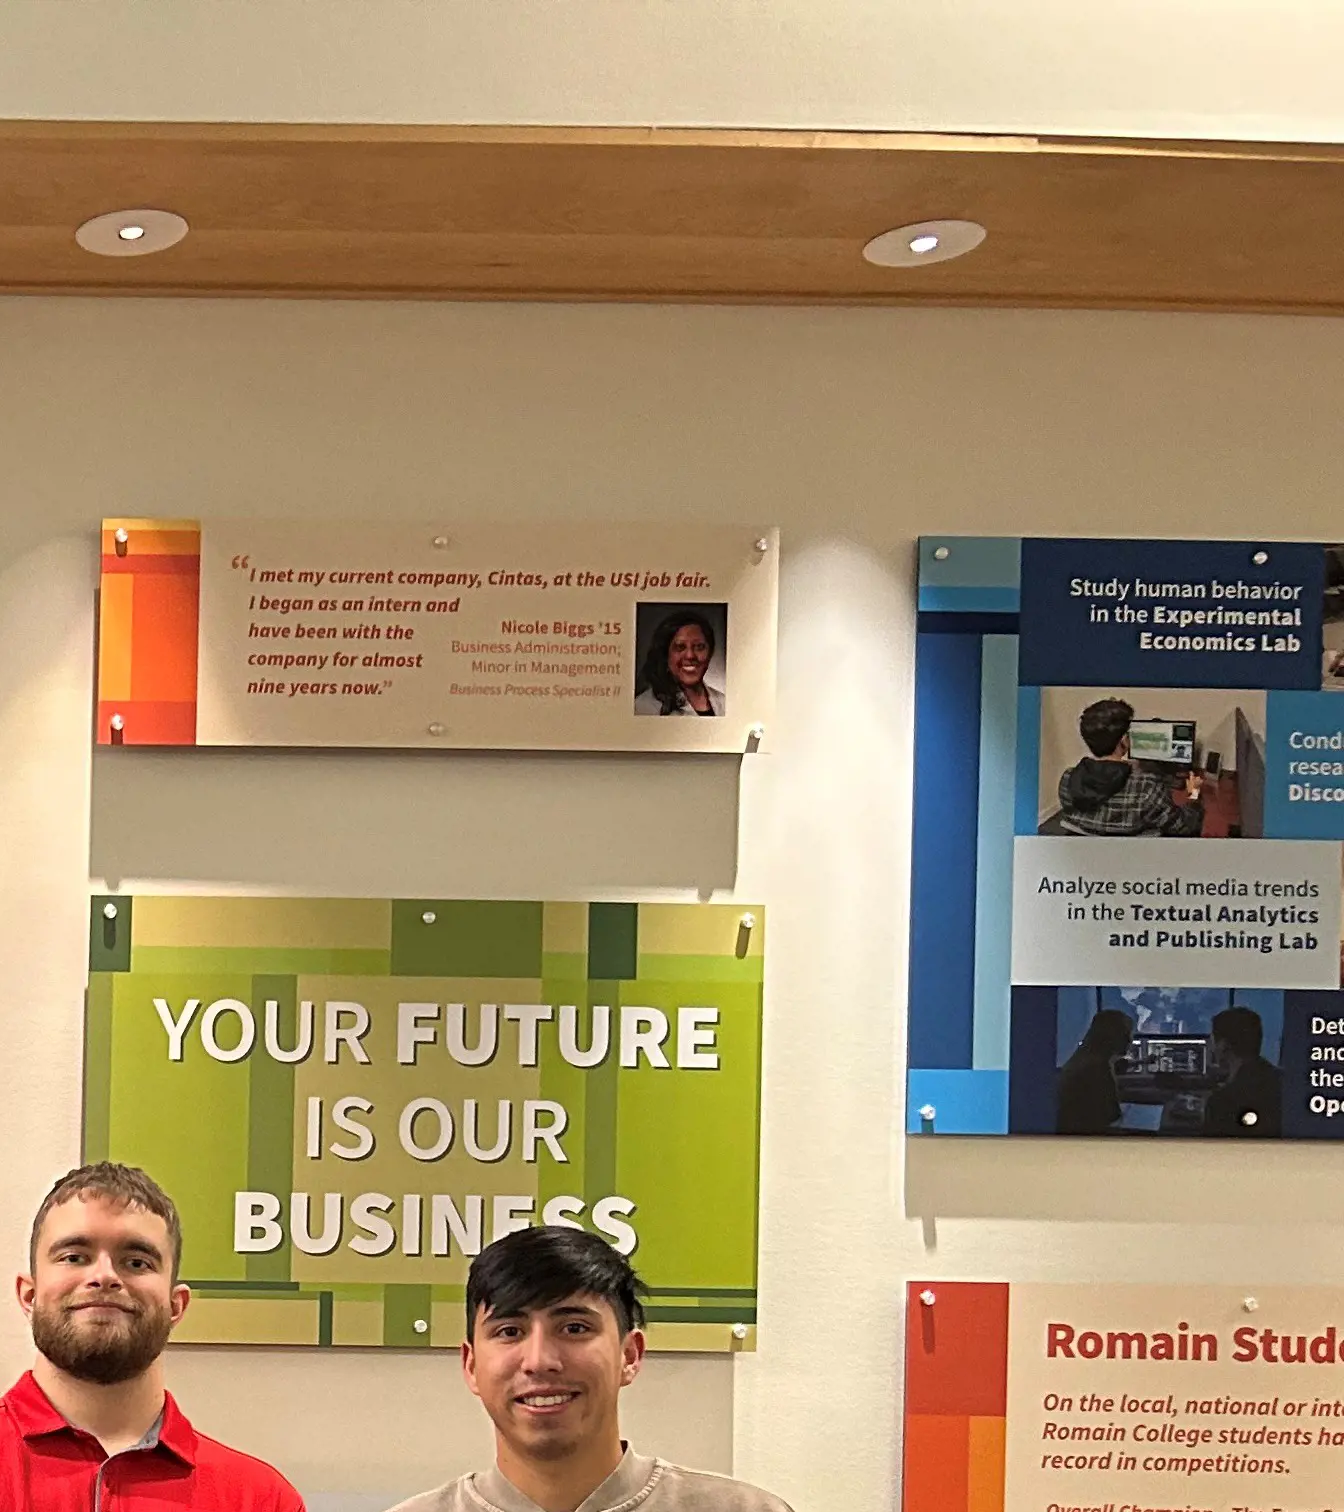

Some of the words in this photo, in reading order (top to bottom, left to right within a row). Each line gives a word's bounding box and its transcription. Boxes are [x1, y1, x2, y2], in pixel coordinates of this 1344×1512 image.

[258, 568, 295, 583] met
[296, 571, 326, 588] my
[328, 569, 394, 584] current
[396, 571, 482, 589] company,
[487, 568, 548, 590] Cintas,
[552, 571, 573, 587] at
[576, 570, 606, 587] the
[610, 571, 640, 588] USI
[639, 570, 672, 592] job
[675, 571, 711, 588] fair.
[1069, 577, 1130, 601] Study
[1134, 577, 1206, 599] human
[1211, 579, 1303, 600] behavior
[1089, 603, 1109, 623] in
[1113, 603, 1149, 624] the
[1152, 605, 1302, 628] Experimental
[450, 639, 512, 654] Business
[513, 639, 622, 658] Administration;
[1139, 631, 1256, 651] Economics
[1260, 633, 1301, 652] Lab
[471, 659, 511, 674] Minor
[514, 660, 527, 673] in
[530, 660, 621, 678] Management
[448, 682, 502, 696] Business
[503, 683, 551, 697] Process
[551, 683, 611, 699] Specialist
[153, 997, 371, 1064] YOUR
[396, 1002, 721, 1070] FUTURE
[306, 1095, 376, 1161] IS
[398, 1098, 568, 1162] OUR
[1047, 1323, 1217, 1361] Romain
[1040, 1450, 1113, 1470] record
[1116, 1456, 1137, 1471] in
[1142, 1452, 1290, 1477] competitions.
